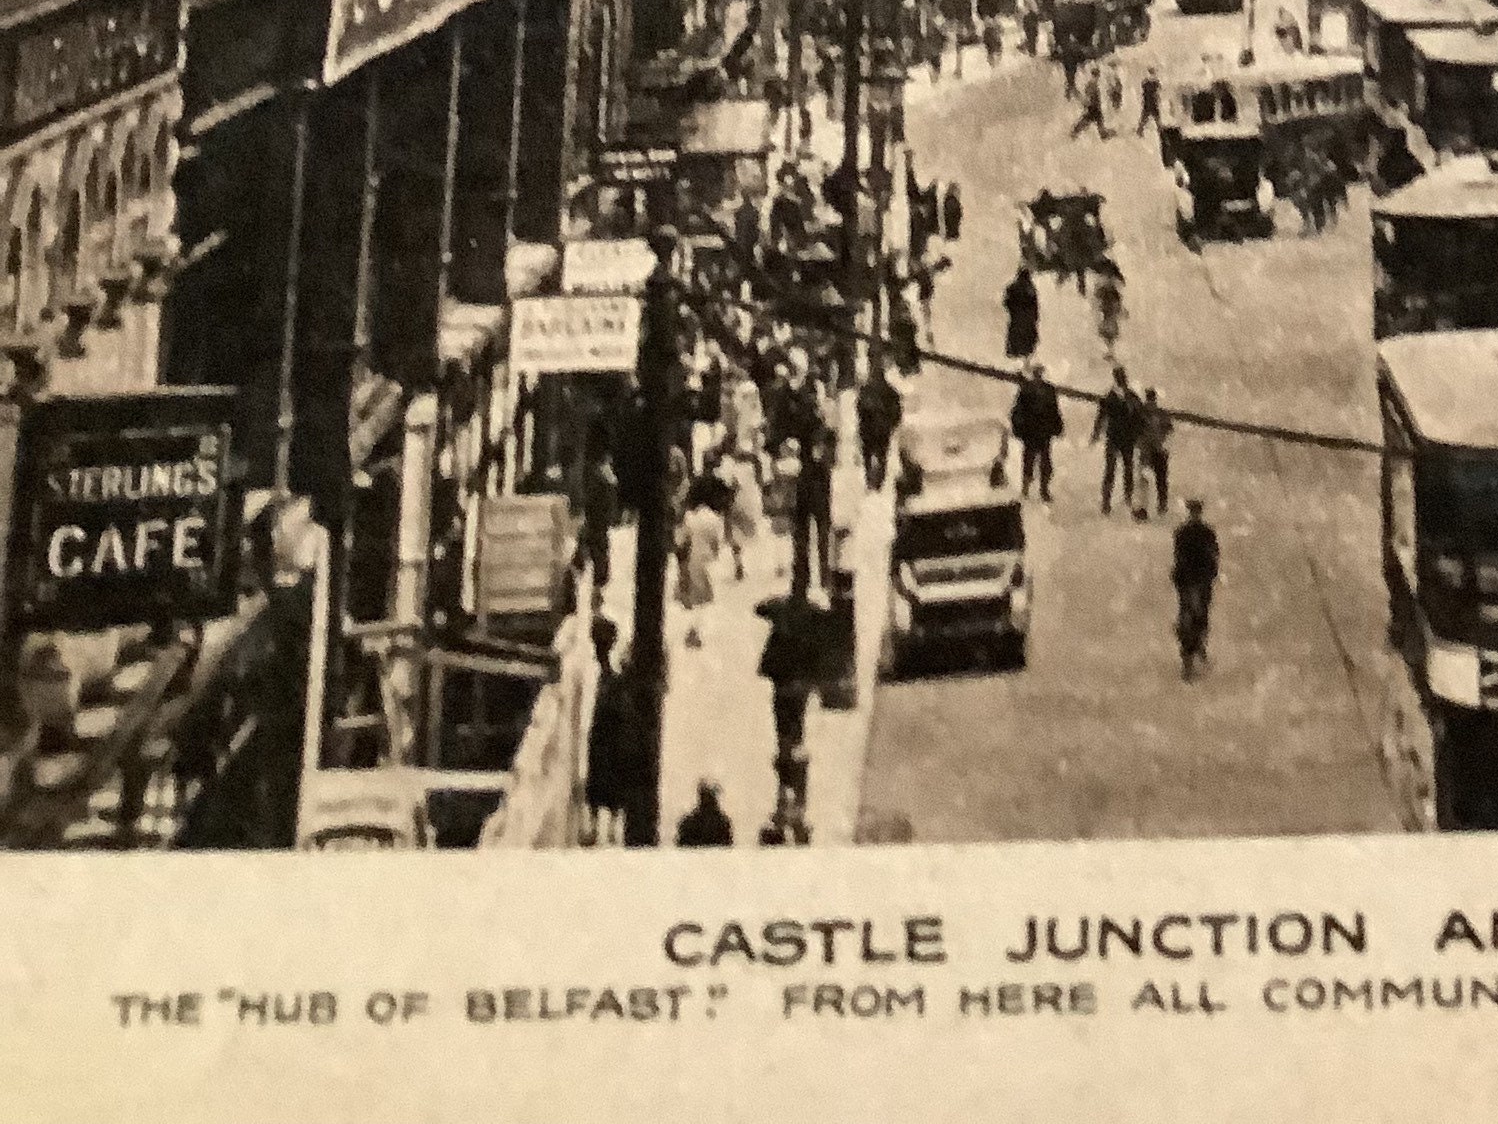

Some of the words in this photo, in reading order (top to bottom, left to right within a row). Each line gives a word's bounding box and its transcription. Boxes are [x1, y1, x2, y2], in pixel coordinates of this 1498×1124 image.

[661, 913, 949, 969] CASTLE
[1005, 909, 1370, 965] JUNCTION
[109, 990, 205, 1029] THE
[363, 989, 431, 1027] OF
[781, 981, 927, 1020] FROM
[957, 980, 1098, 1019] HERE
[1130, 979, 1228, 1018] ALL
